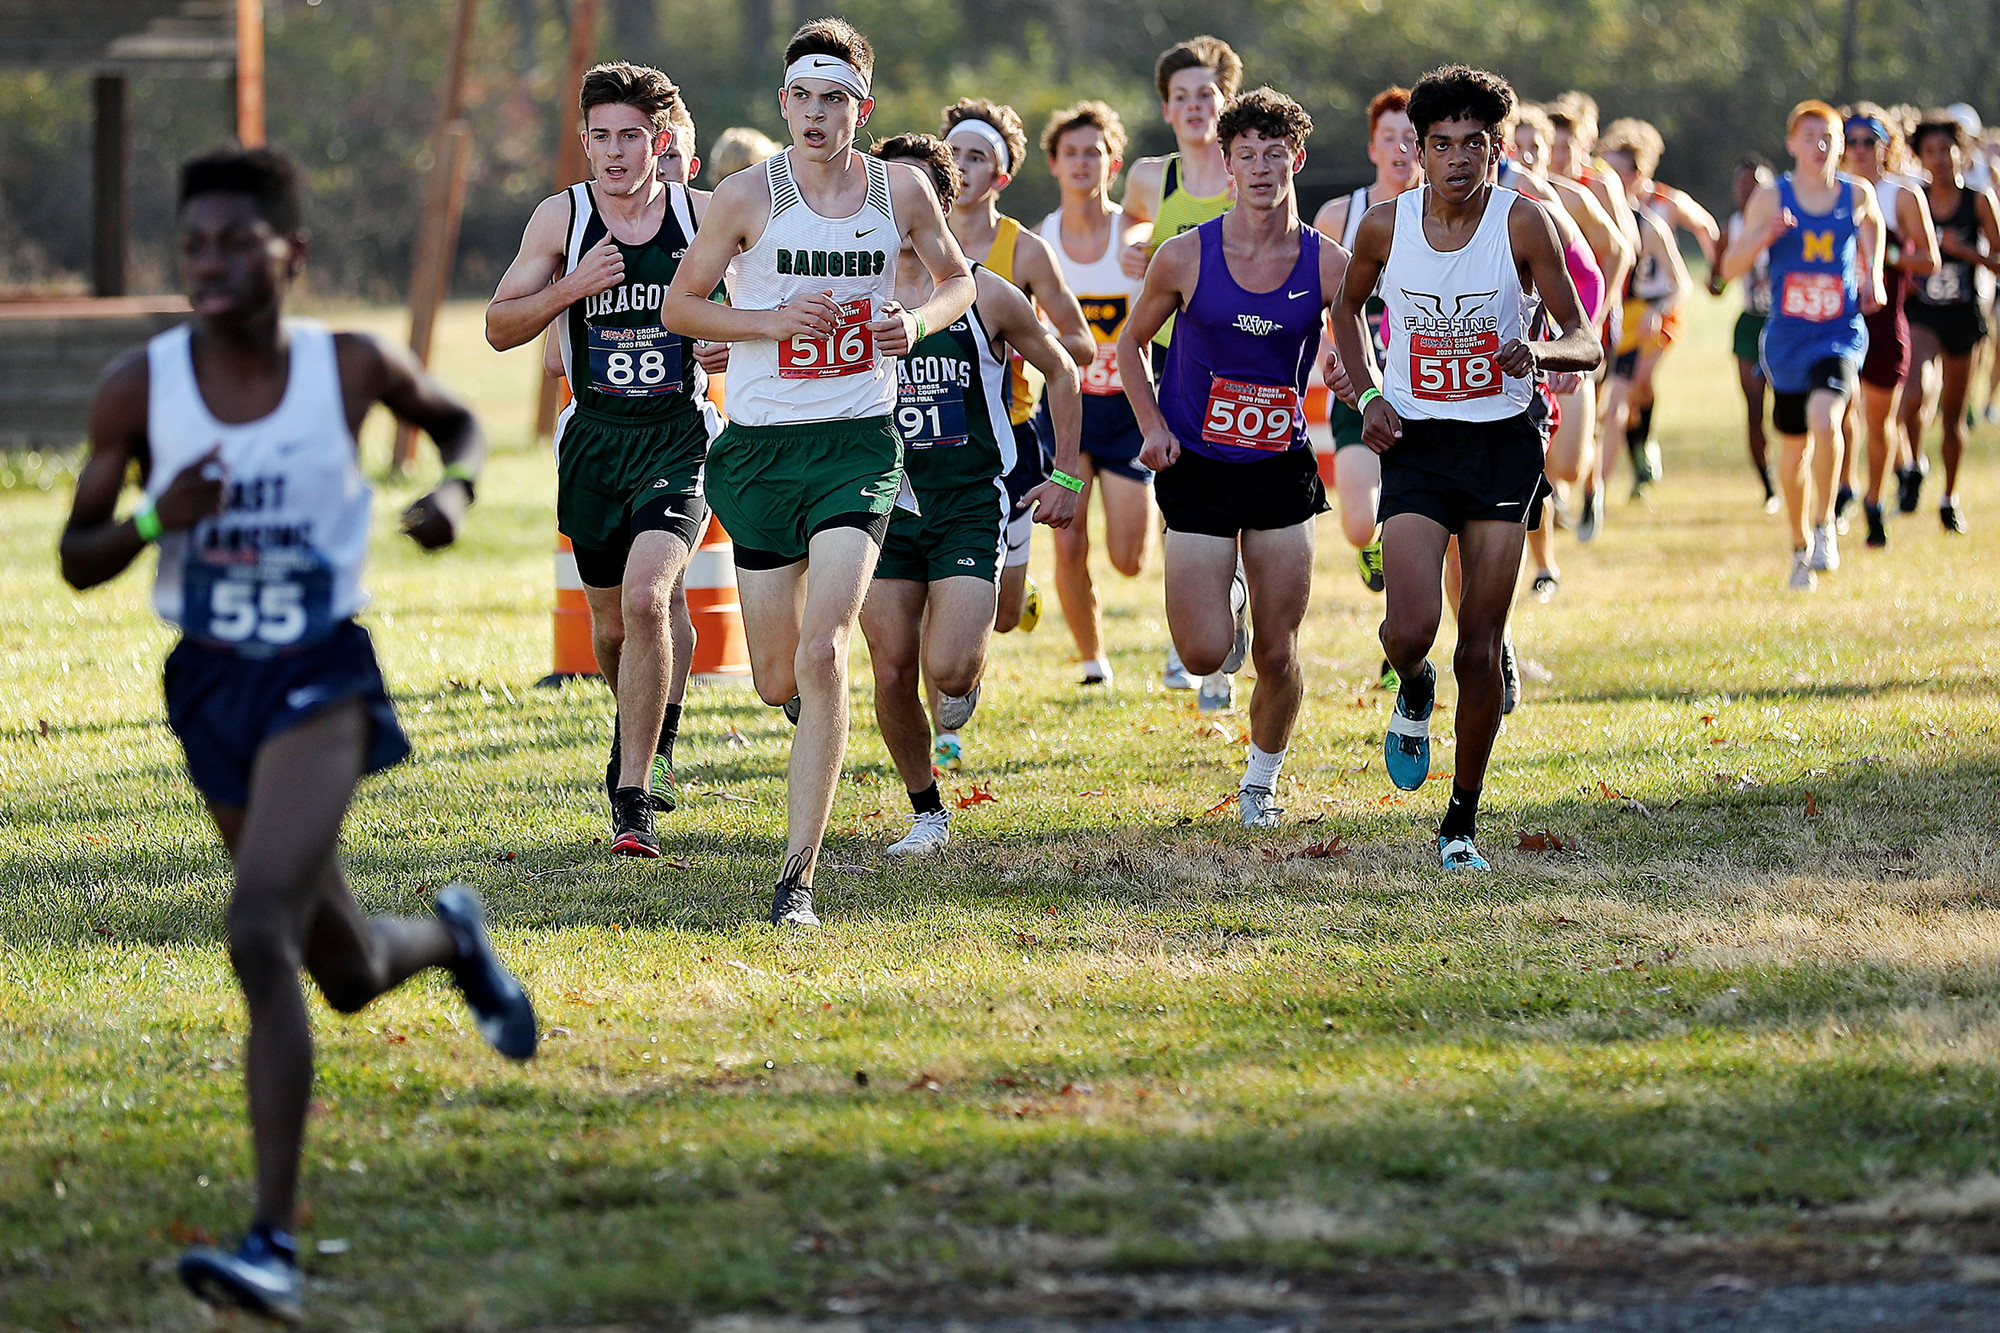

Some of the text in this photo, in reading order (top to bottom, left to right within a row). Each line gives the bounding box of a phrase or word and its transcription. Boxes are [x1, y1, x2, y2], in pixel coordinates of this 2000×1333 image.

[1803, 230, 1835, 262] M
[776, 248, 886, 277] RANGERS
[637, 332, 668, 340] COUNTRY
[1403, 316, 1498, 332] FLUSHING
[635, 340, 654, 348] FINAL
[790, 326, 865, 366] 516
[1454, 340, 1486, 349] COUNTRY
[607, 350, 666, 385] 88
[1420, 357, 1493, 389] 518
[917, 388, 949, 396] COUNTRY
[1256, 391, 1286, 399] COUNTRY
[898, 405, 942, 439] 91
[1203, 400, 1291, 439] 509
[209, 580, 308, 644] 55
